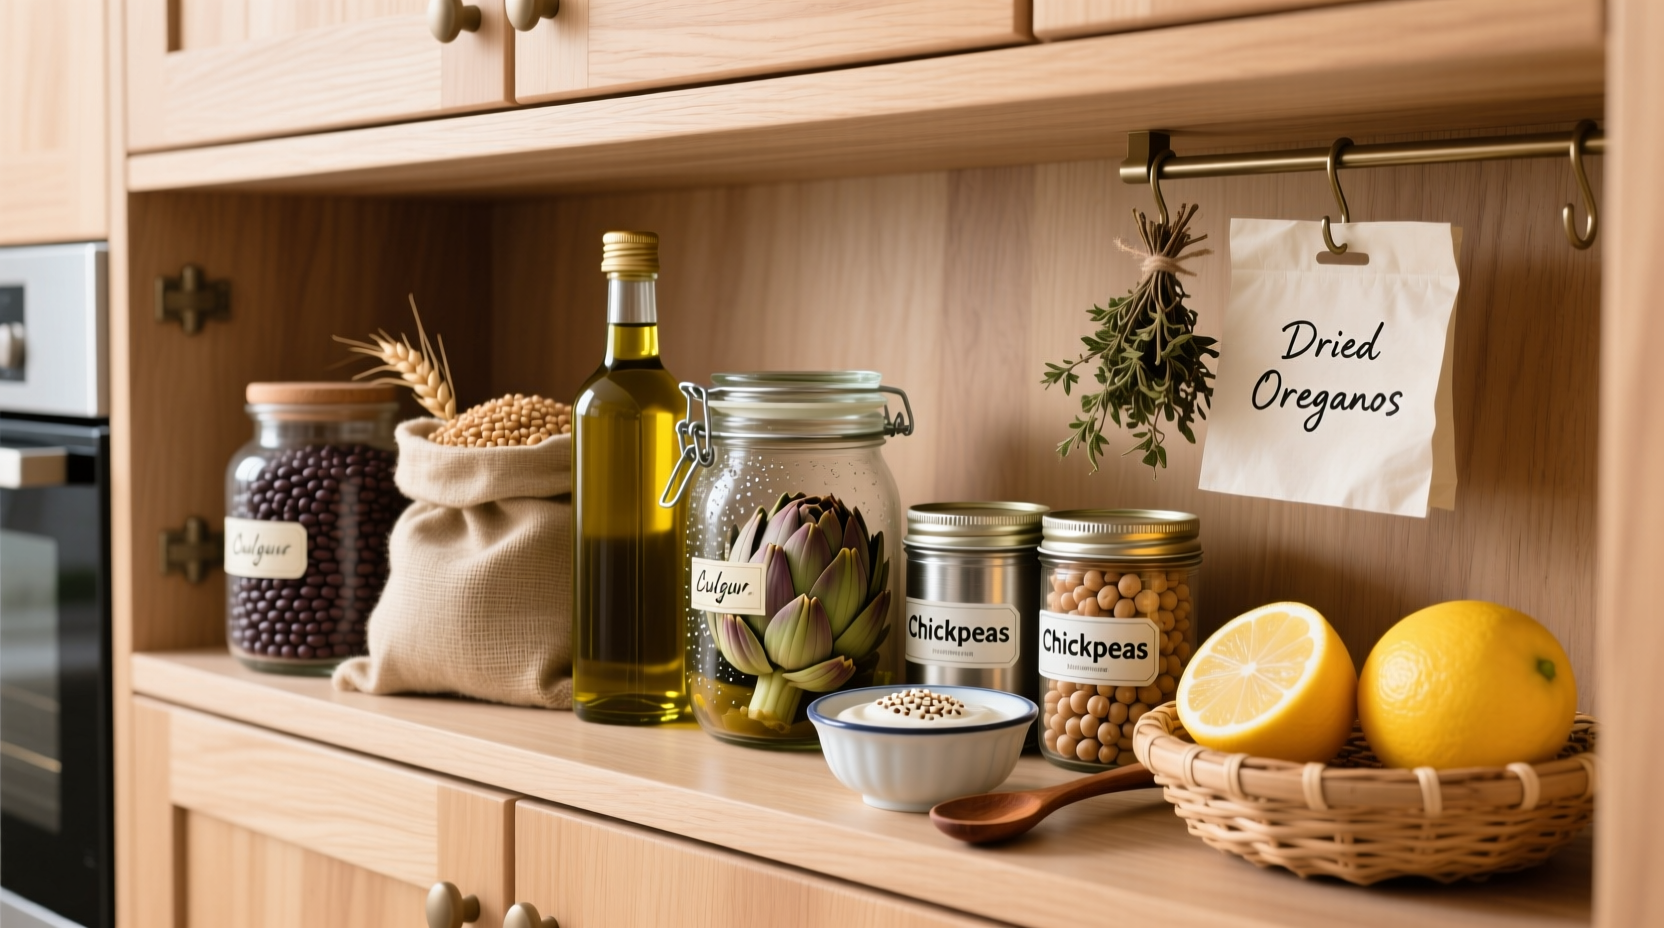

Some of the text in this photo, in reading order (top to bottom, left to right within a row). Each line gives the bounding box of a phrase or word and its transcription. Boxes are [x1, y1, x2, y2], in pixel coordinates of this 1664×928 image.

[1281, 320, 1384, 360] Dried
[1252, 369, 1403, 432] Oreganos
[908, 614, 1010, 647] Chickpeas
[1043, 628, 1148, 663] Chickpeas
